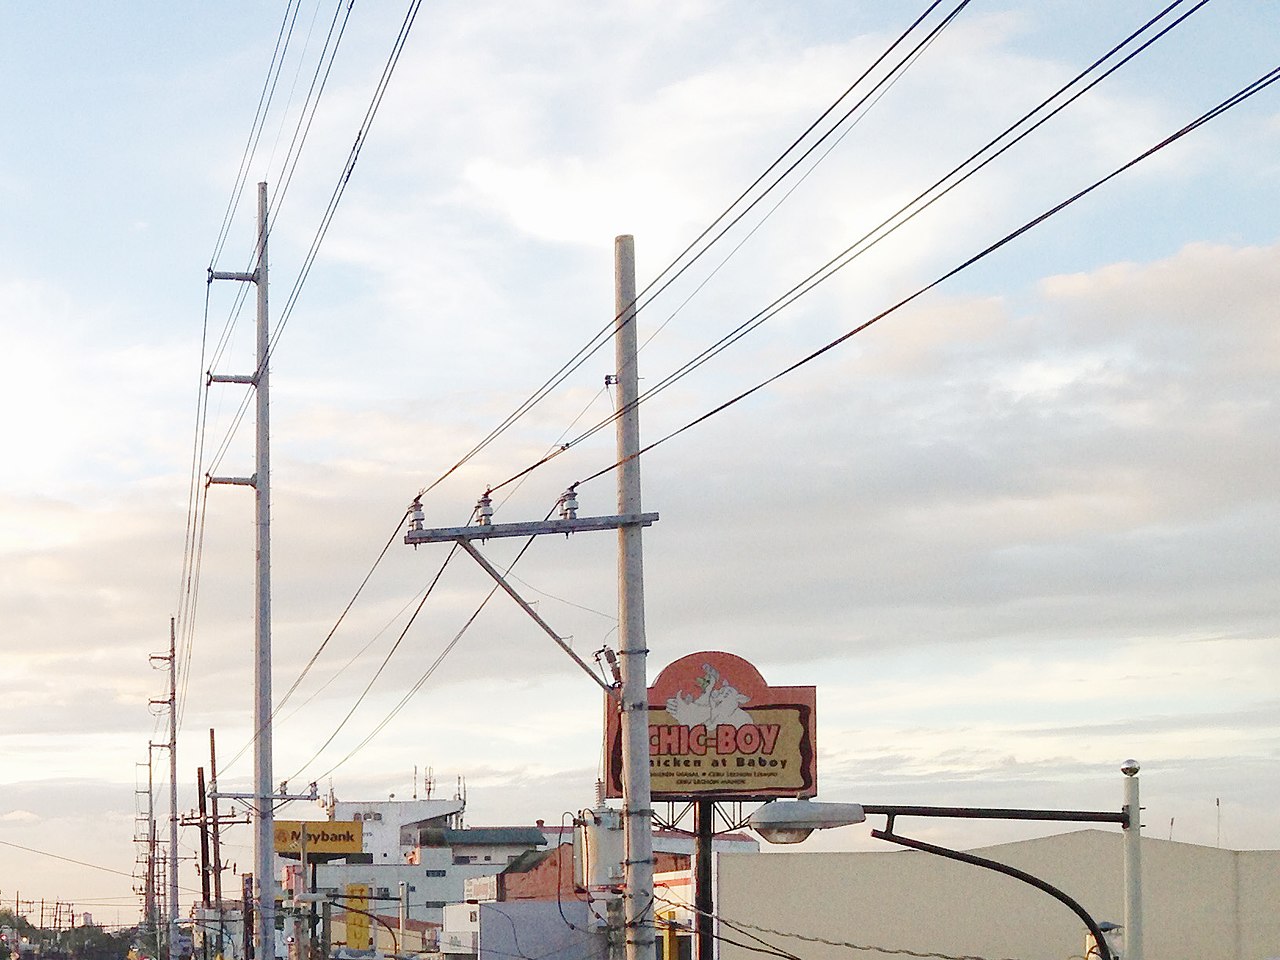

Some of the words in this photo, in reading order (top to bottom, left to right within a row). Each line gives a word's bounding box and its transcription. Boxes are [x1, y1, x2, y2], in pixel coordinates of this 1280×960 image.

[649, 757, 701, 767] hicken
[711, 758, 727, 767] at
[736, 756, 788, 769] Baboy
